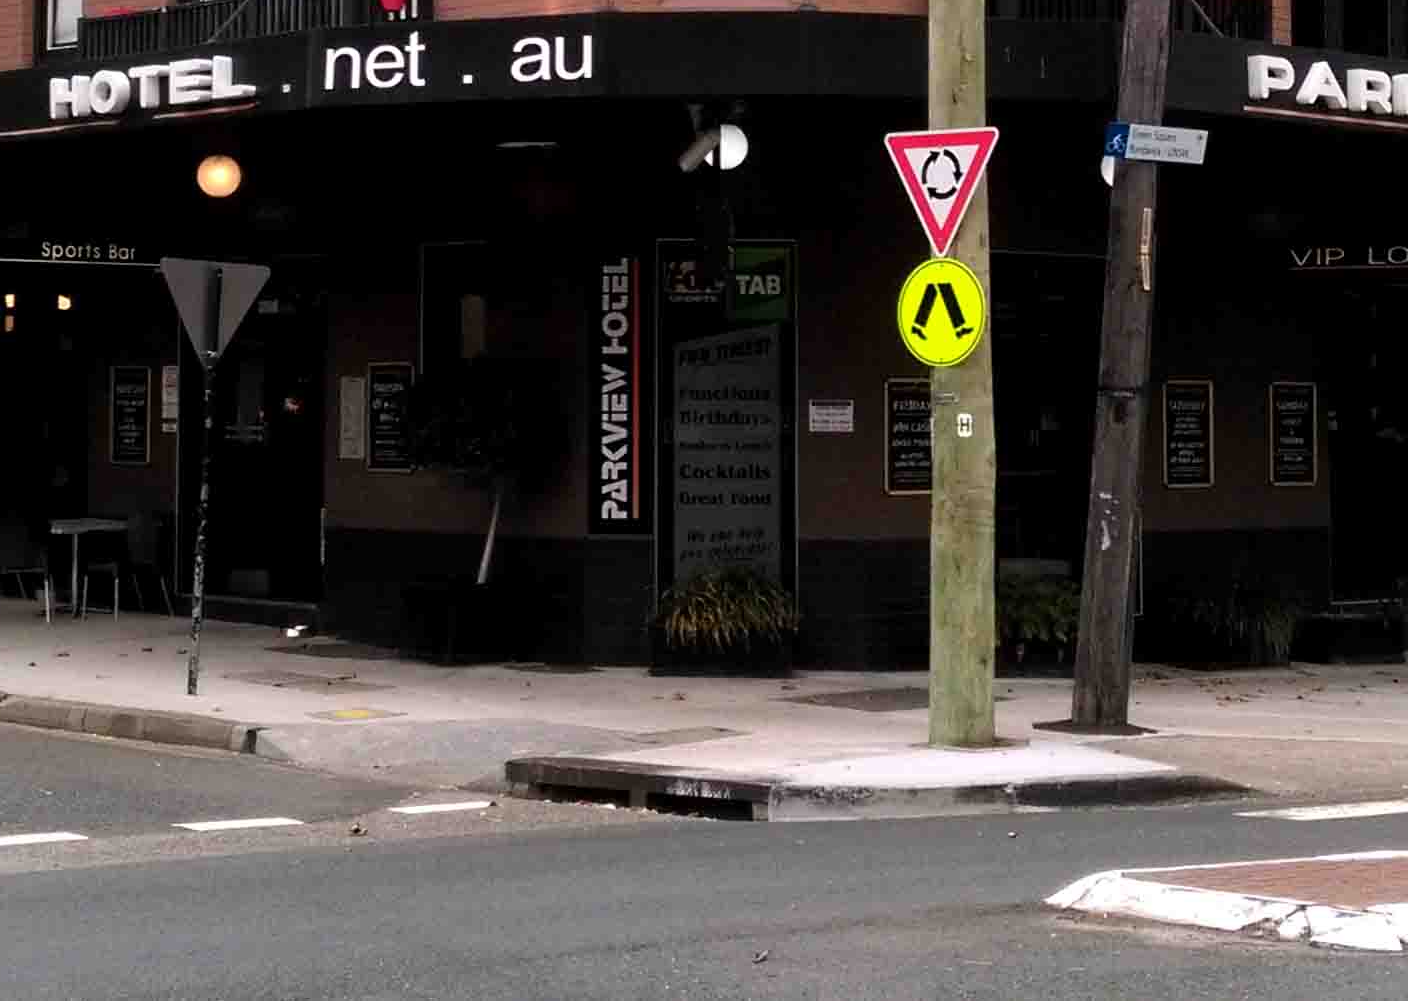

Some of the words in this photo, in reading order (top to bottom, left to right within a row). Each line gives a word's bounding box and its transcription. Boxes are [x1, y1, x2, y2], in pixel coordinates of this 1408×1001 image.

[50, 55, 256, 119] HOTEL
[41, 241, 101, 261] Sports
[108, 243, 136, 260] Bar
[1289, 247, 1344, 266] VIP
[735, 273, 782, 294] TAB
[600, 256, 630, 356] HOTEL
[600, 362, 629, 520] PARKVIEW
[678, 463, 771, 479] Cocktails
